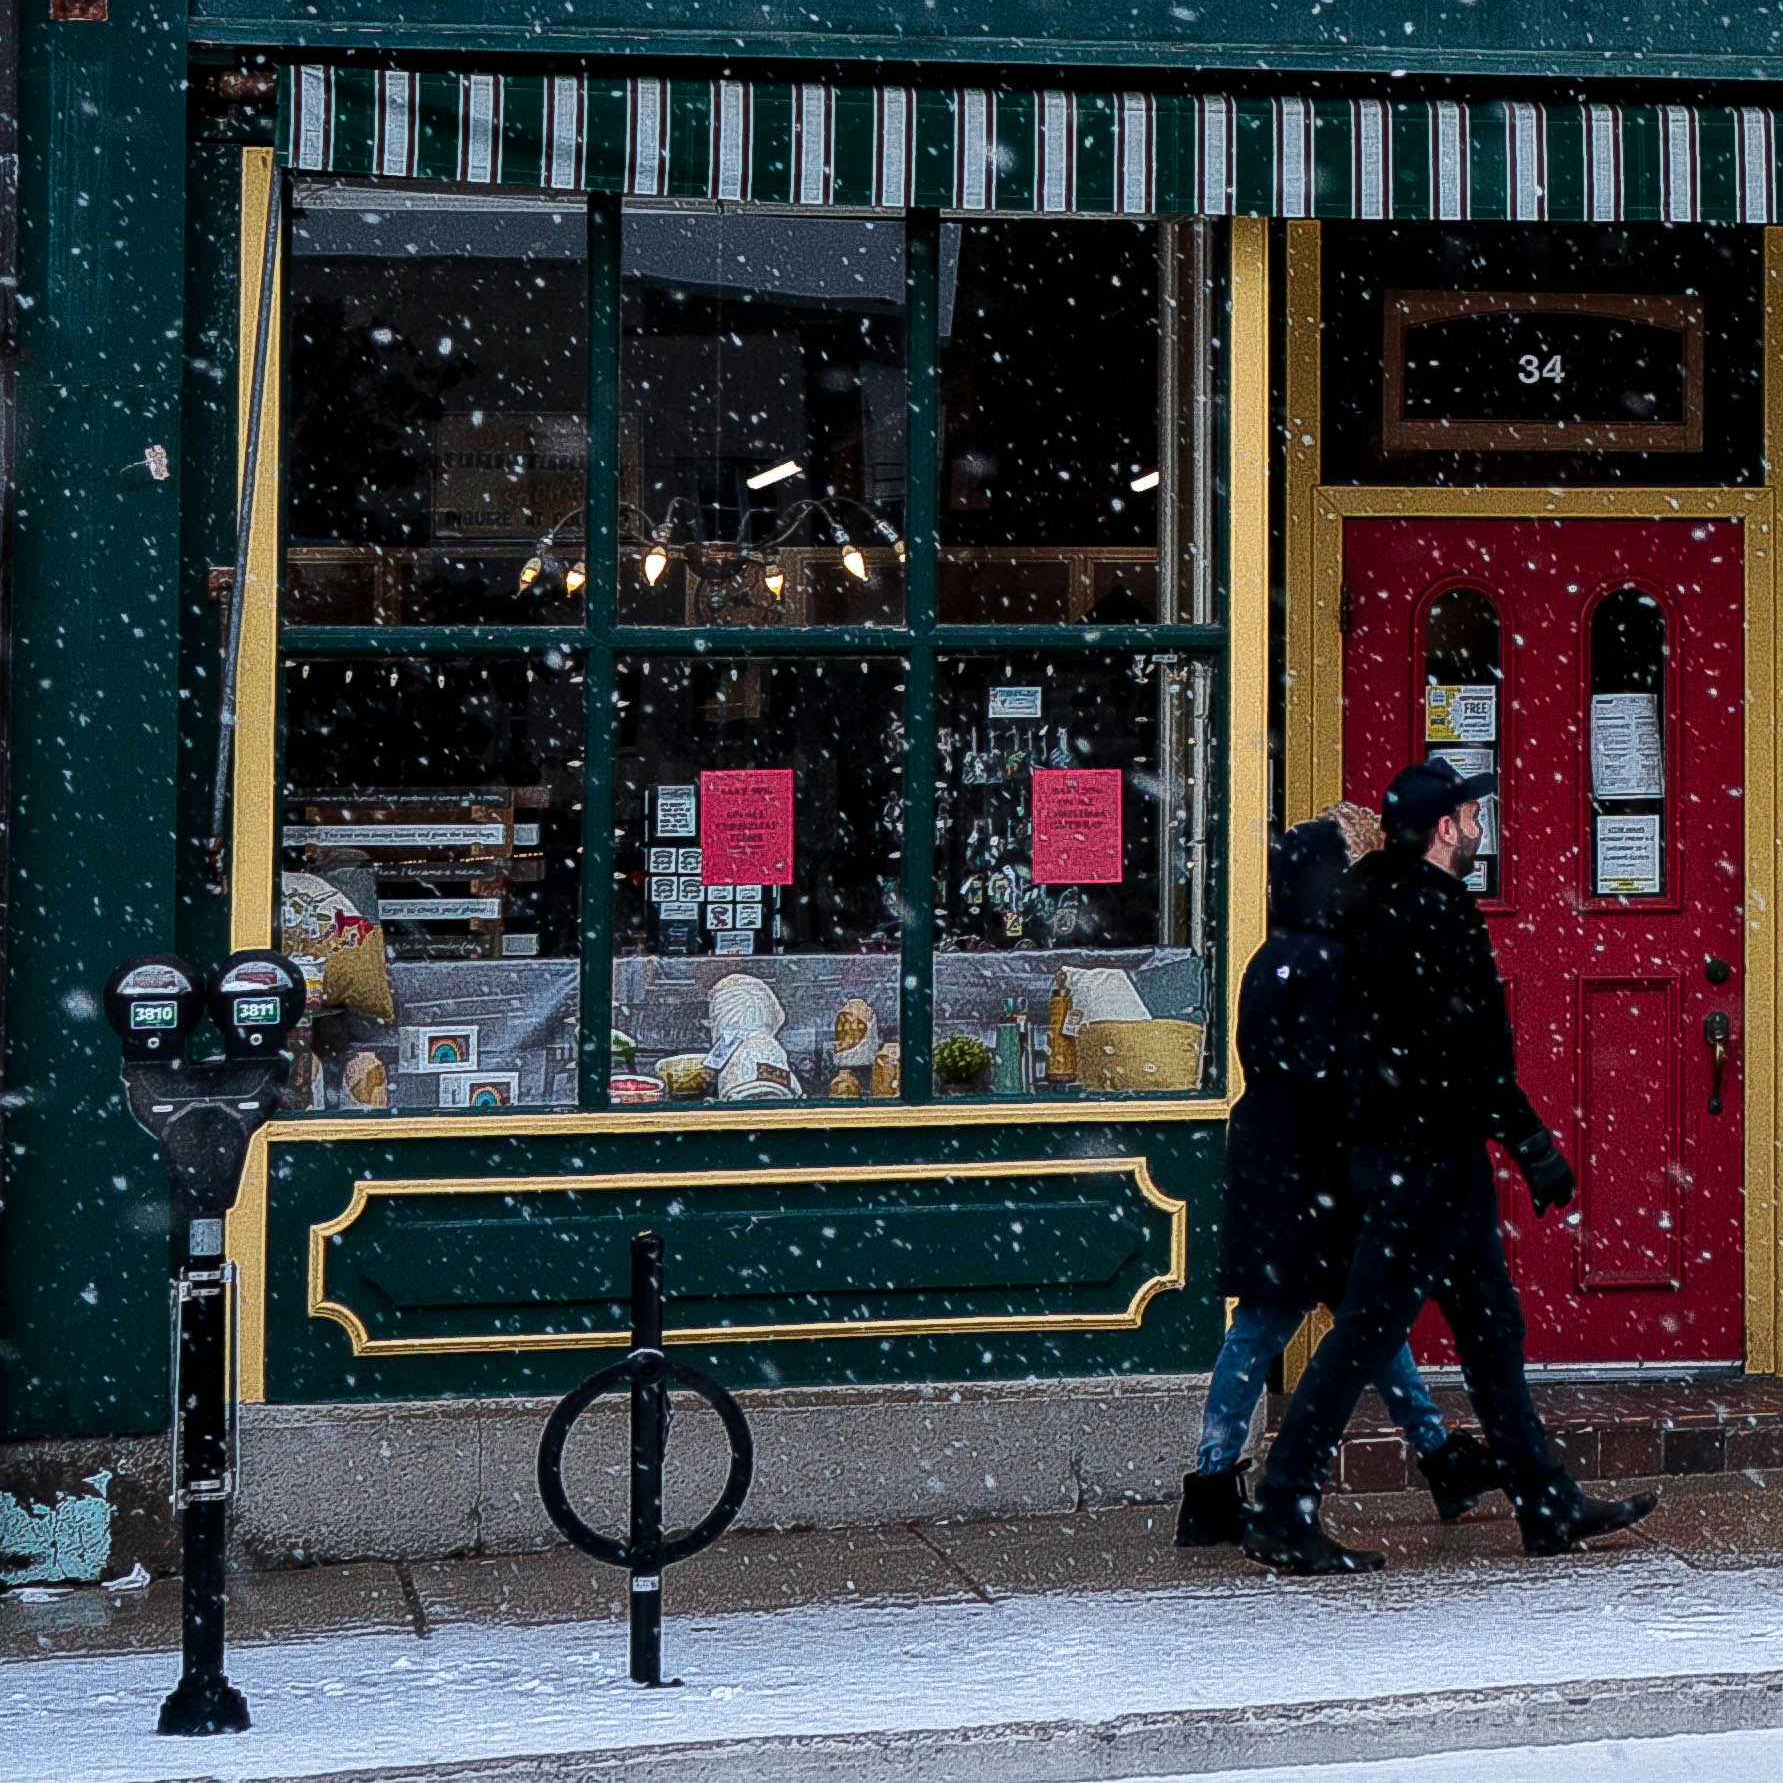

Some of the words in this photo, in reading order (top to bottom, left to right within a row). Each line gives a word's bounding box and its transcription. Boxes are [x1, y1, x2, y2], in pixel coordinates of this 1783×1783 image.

[1518, 354, 1566, 385] 34
[1463, 701, 1487, 715] FREE
[134, 1006, 173, 1021] 3810
[238, 1002, 274, 1018] 3811
